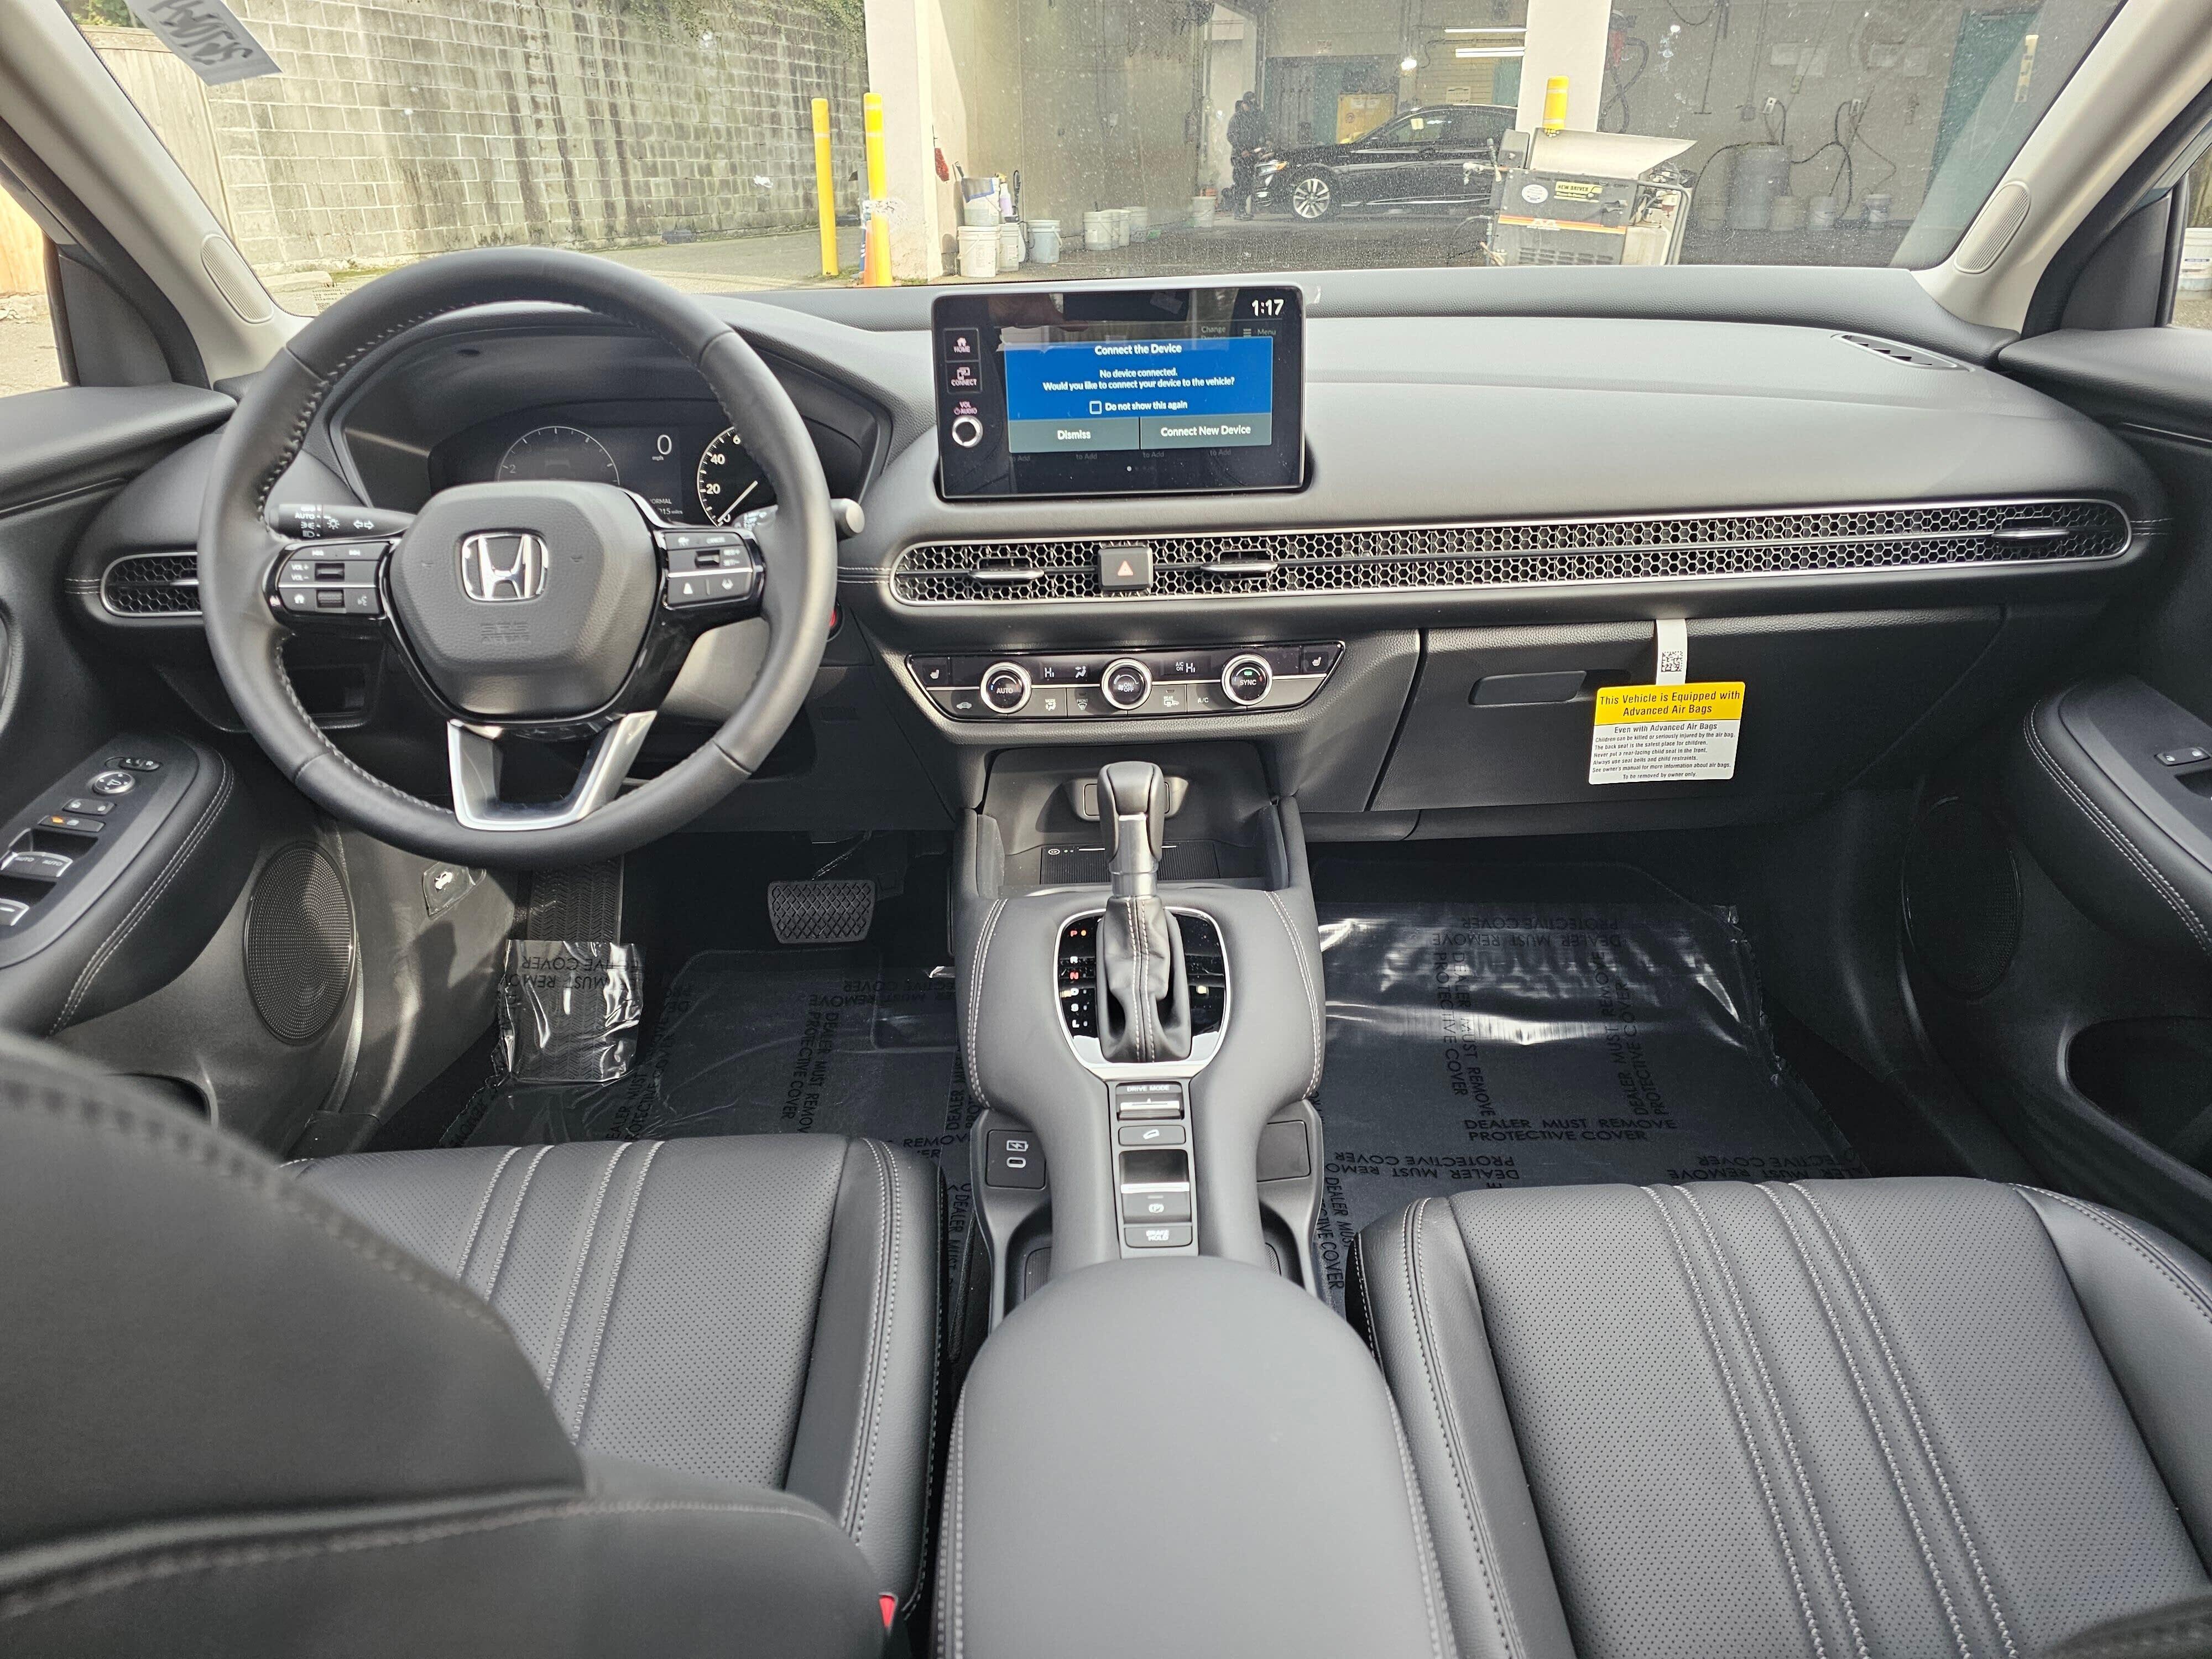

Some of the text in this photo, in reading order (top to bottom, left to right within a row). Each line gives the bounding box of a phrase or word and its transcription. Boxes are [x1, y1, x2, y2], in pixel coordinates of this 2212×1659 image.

[1251, 299, 1284, 316] 1:17
[1094, 343, 1182, 356] Connect the Device
[1099, 367, 1178, 378] No device connected.
[951, 378, 977, 387] CONNECT
[1042, 376, 1235, 392] Would you like to connect your device to the vehicle?
[1105, 400, 1188, 411] Do not show this again
[1057, 429, 1091, 440] Dismiss
[1161, 424, 1251, 437] Connect New Device
[657, 434, 672, 455] 0
[711, 453, 726, 465] 40
[706, 483, 721, 494] 20
[1600, 690, 1740, 705] This Vehicle is Equipped with
[1623, 704, 1712, 716] Advanced Air Bags
[1433, 933, 1501, 946] REMOVE
[521, 957, 578, 971] COVER
[1070, 971, 1079, 980] N
[1072, 1020, 1079, 1028] L
[1444, 1048, 1469, 1097] COVER
[1468, 1066, 1496, 1117] REMOVE
[797, 1092, 820, 1134] REMOV
[1464, 1118, 1679, 1130] DEALER MUST REMOVE
[1469, 1130, 1648, 1142] PROTECTIVE COVER
[1334, 1151, 1515, 1167] PROTECTIVE COVER
[1697, 1155, 1766, 1167] COVER
[1391, 1167, 1520, 1180] DEALER MUST
[1667, 1168, 1750, 1180] REMOVE
[1326, 1177, 1349, 1216] DEALER
[948, 1194, 969, 1233] DEALER
[1321, 1241, 1345, 1289] COVER
